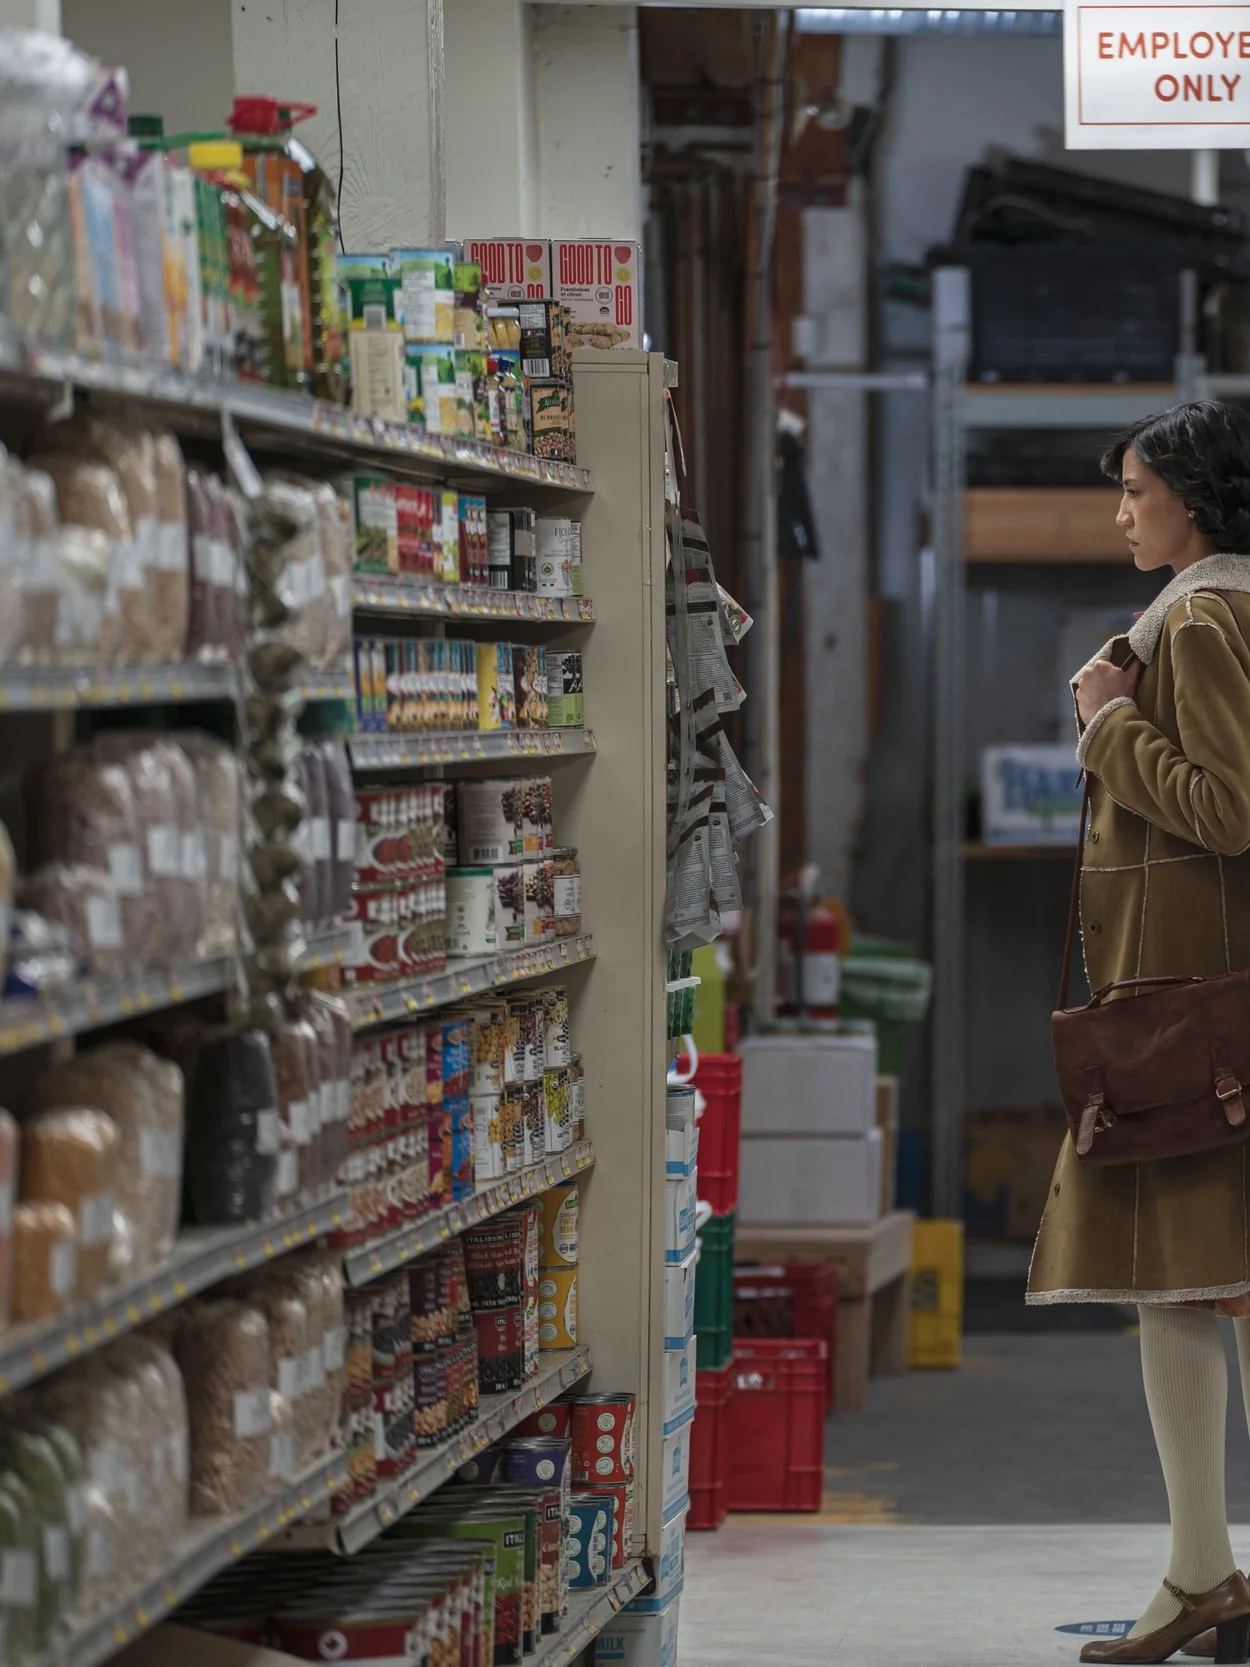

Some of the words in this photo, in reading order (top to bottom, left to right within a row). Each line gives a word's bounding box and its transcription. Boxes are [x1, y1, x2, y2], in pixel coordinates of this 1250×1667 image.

[1154, 74, 1242, 102] ONLY
[507, 243, 524, 284] TO
[560, 244, 594, 285] GOOD
[595, 244, 612, 285] TO
[615, 285, 632, 325] GO
[596, 1636, 624, 1651] MILK
